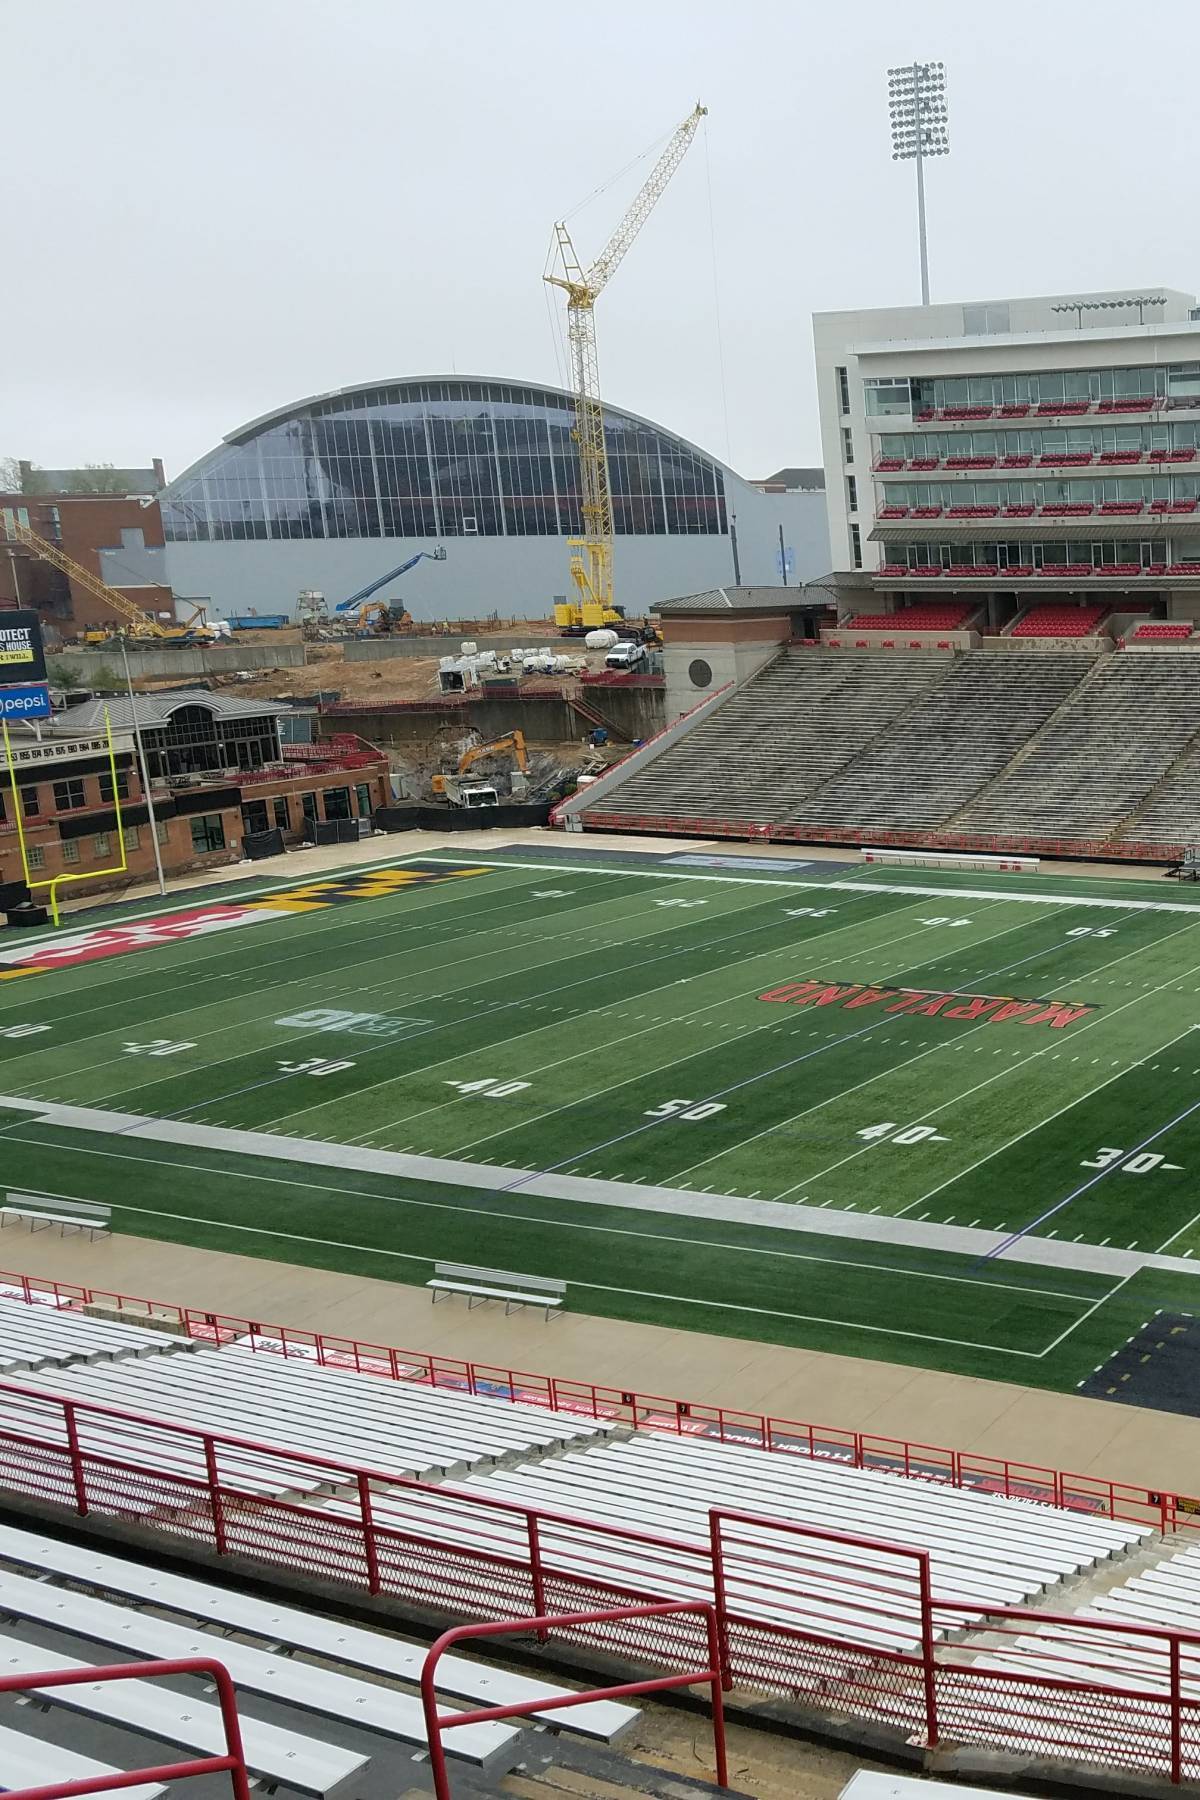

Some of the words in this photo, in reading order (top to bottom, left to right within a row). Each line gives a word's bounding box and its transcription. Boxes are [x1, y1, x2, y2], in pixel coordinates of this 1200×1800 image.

[6, 641, 32, 651] HOUSE
[5, 695, 45, 712] pepsi
[657, 897, 709, 907] 20
[799, 907, 839, 917] 30
[927, 917, 973, 927] 40
[1066, 927, 1118, 938] 50
[757, 981, 1096, 1028] MARYLAND
[128, 1039, 198, 1056] 20
[280, 1057, 357, 1076] 30
[455, 1078, 533, 1098] 40
[644, 1099, 727, 1121] 50
[856, 1122, 937, 1145] 40
[1080, 1147, 1166, 1174] 30
